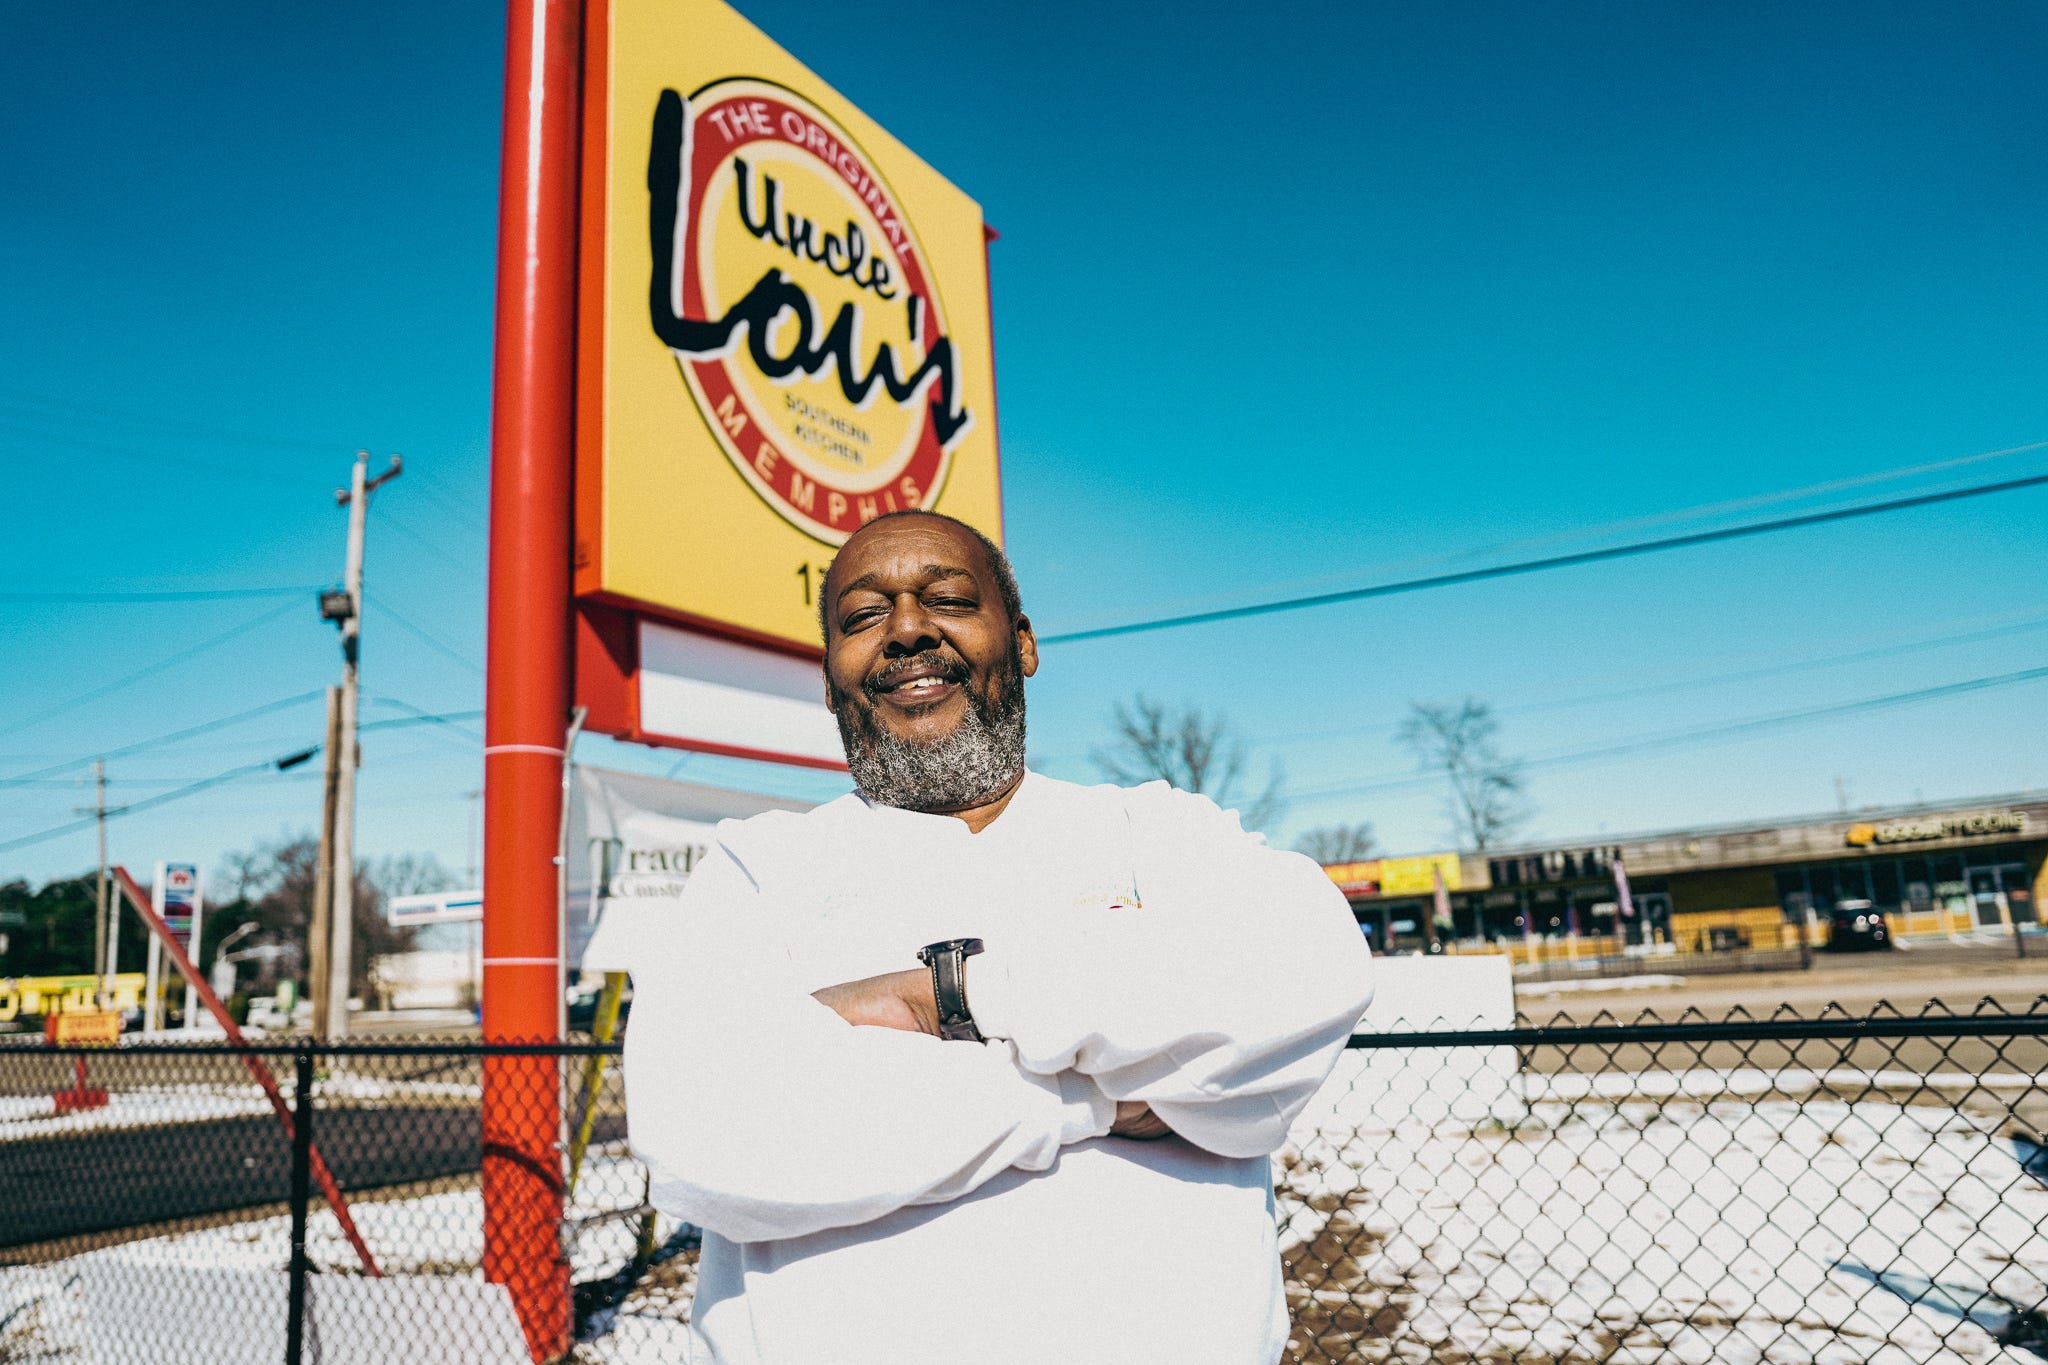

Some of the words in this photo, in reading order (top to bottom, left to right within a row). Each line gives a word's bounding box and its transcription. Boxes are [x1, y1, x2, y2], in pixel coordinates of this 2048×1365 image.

[708, 102, 776, 142] THE
[780, 111, 912, 266] ORIGINAL
[733, 155, 896, 300] Uncle
[716, 393, 923, 525] MEMPHIS
[784, 391, 870, 444] SOUTHERN
[795, 422, 864, 464] KITCHEN
